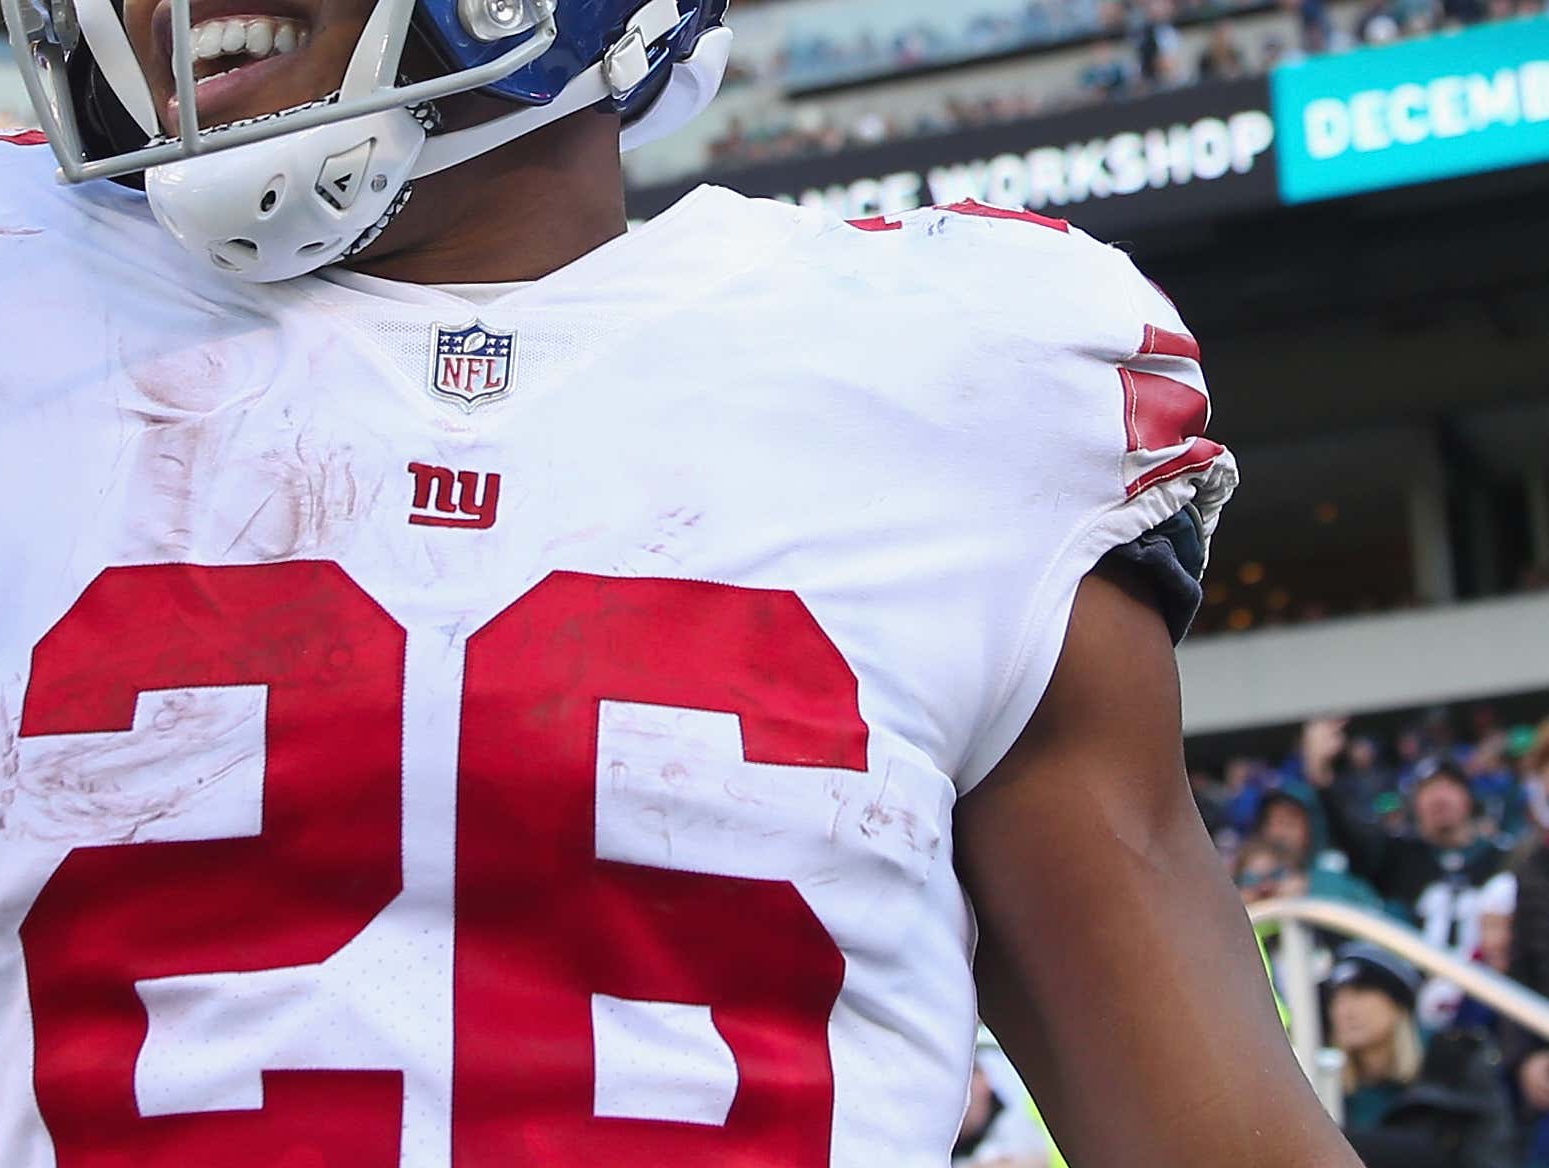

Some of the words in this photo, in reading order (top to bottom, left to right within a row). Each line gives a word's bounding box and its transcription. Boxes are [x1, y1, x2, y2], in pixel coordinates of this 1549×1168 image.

[927, 110, 1275, 209] WORKSHOP
[441, 355, 502, 393] NFL
[407, 461, 501, 529] ny
[18, 559, 869, 1168] 26
